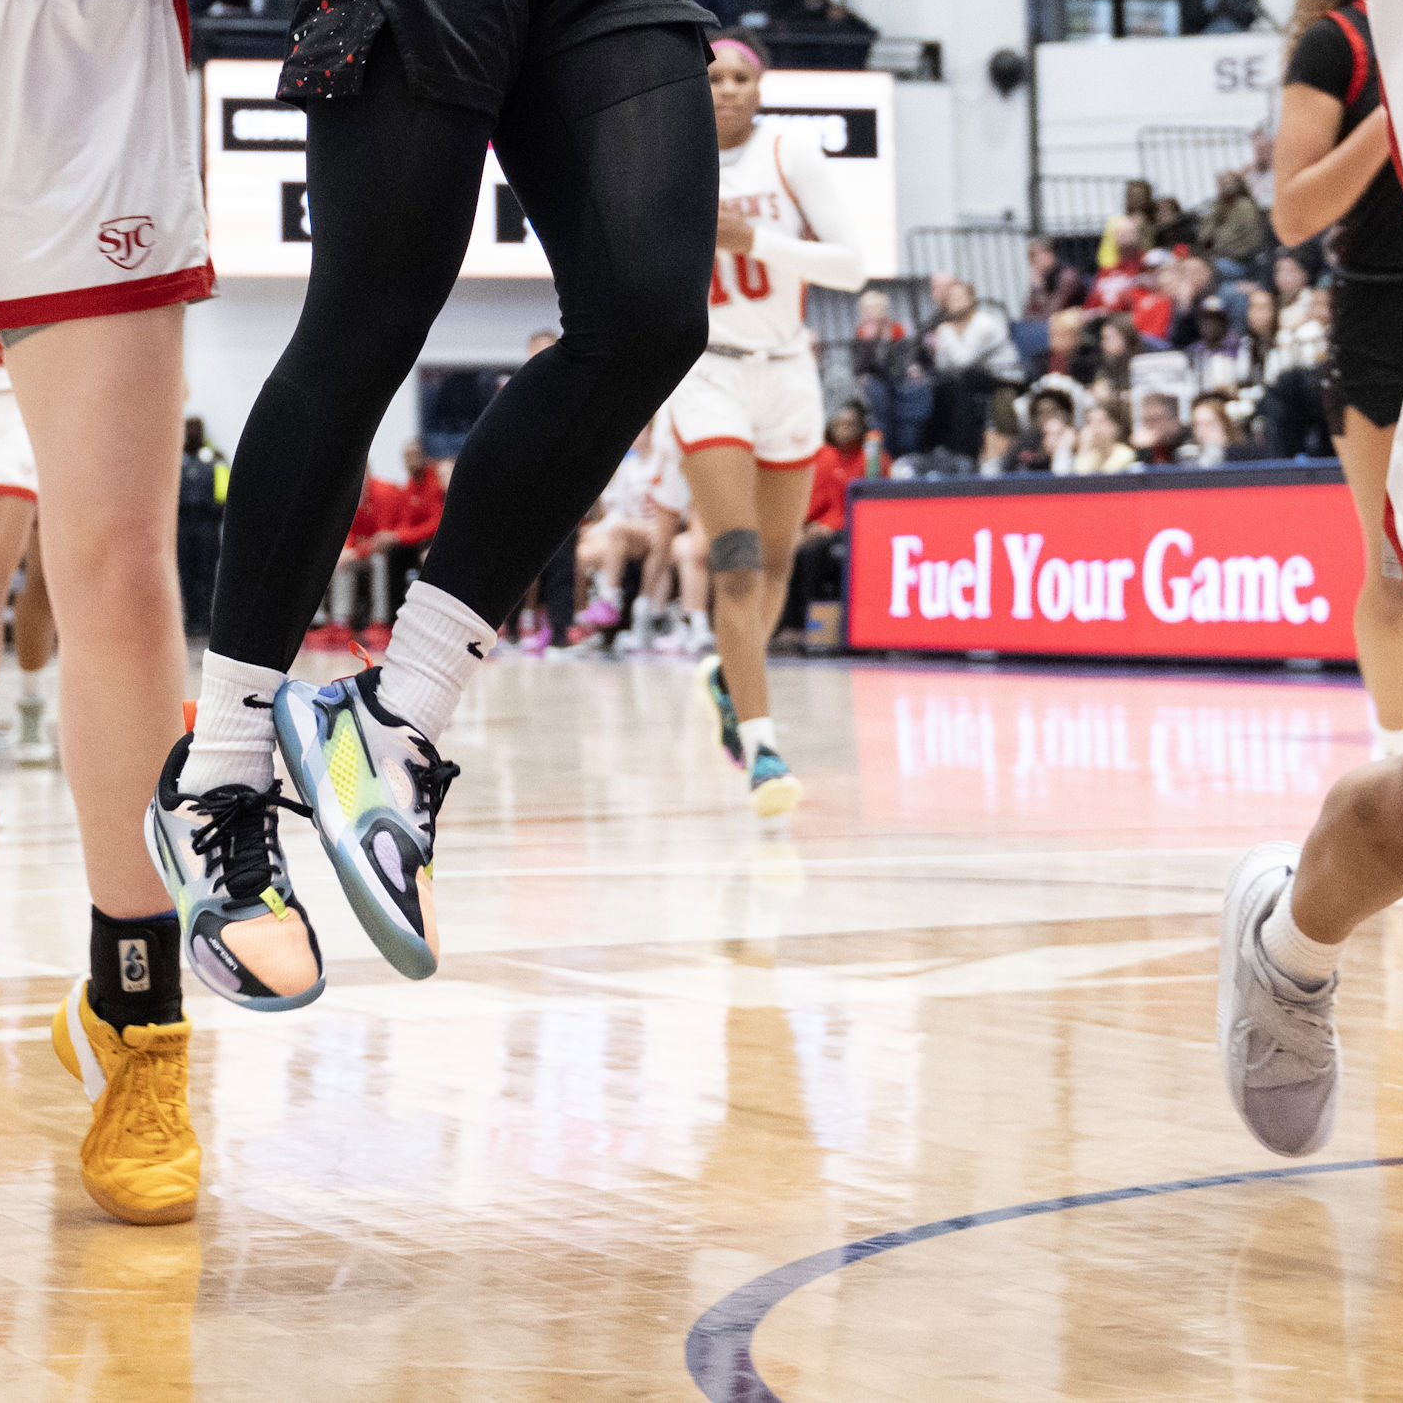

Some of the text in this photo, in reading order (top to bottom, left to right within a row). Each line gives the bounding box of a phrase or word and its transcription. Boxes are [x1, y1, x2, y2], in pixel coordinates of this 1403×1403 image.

[1213, 54, 1269, 94] SE
[97, 220, 156, 262] SJC
[889, 527, 1331, 625] Fuel Your Game.
